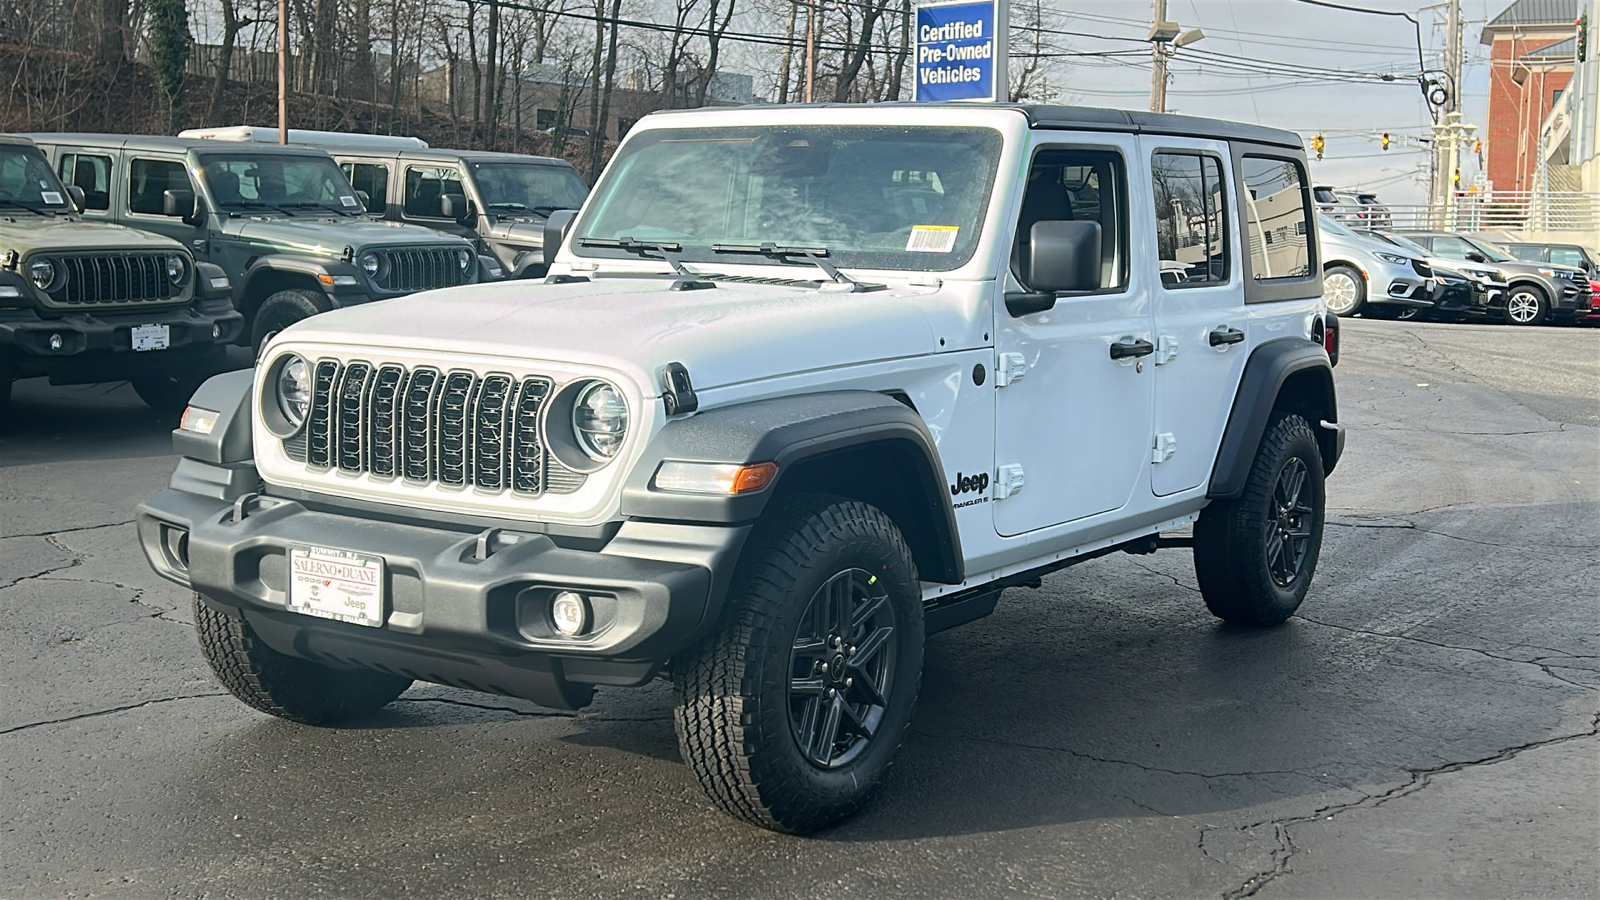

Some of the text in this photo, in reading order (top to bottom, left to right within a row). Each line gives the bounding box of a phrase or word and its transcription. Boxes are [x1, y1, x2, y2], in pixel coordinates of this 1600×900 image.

[920, 20, 982, 42] Certified
[920, 41, 991, 63] Pre-Owned
[920, 65, 980, 85] Vehicles
[951, 472, 989, 495] Jeep
[953, 498, 982, 509] RANGLER
[311, 546, 340, 557] SUMMIT
[294, 559, 377, 583] SALERNO DUANE
[345, 597, 366, 610] Jeep
